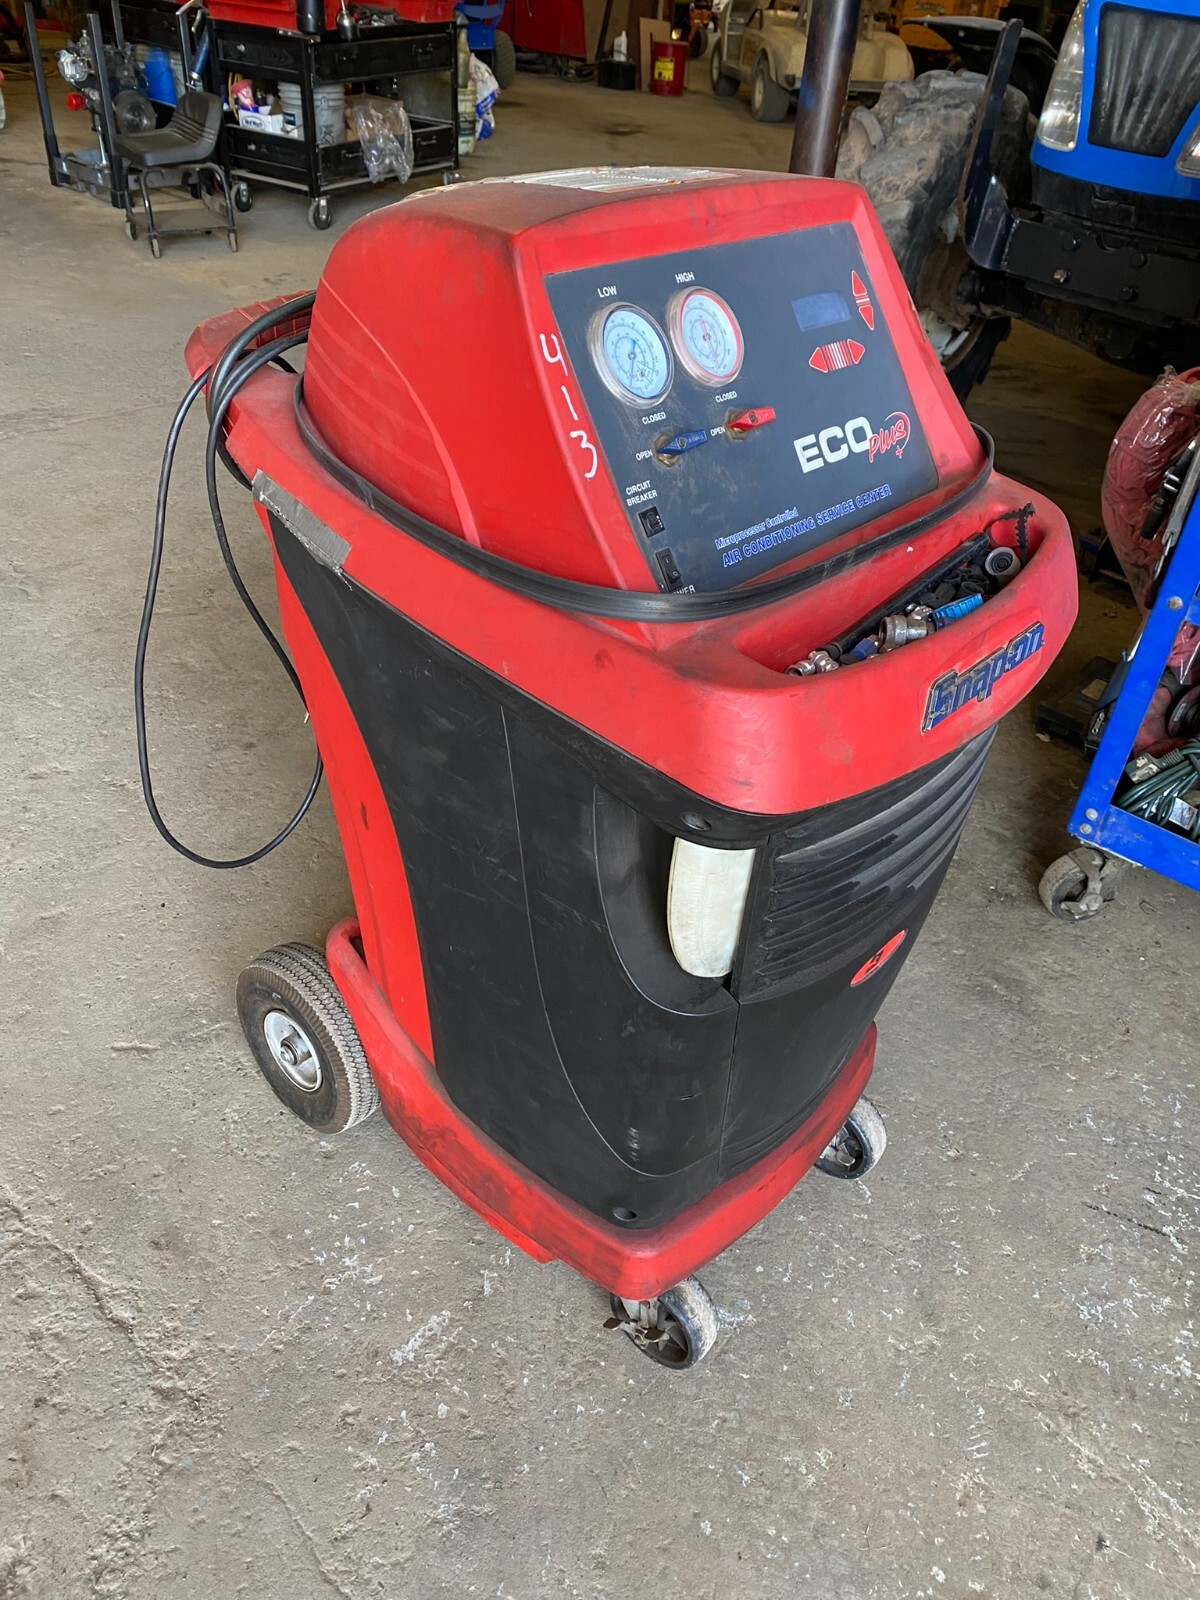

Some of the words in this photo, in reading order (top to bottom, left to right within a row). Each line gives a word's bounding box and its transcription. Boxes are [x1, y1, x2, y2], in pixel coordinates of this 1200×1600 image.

[675, 272, 695, 283] HIGH
[597, 285, 617, 298] LOW
[715, 390, 738, 403] CLOSED
[642, 411, 667, 425] CLOSED
[710, 426, 726, 437] OPEN
[793, 416, 873, 474] ECO
[868, 419, 907, 463] plus
[636, 449, 653, 462] OPEN
[625, 480, 651, 495] CIRCUIT
[626, 489, 658, 507] BREAKER
[714, 523, 766, 550] Microprocessor
[765, 507, 799, 529] Controlled
[722, 548, 742, 568] AIR
[743, 516, 816, 558] CONDITIONING
[816, 499, 855, 526] SERVICE
[855, 484, 892, 509] CENTER
